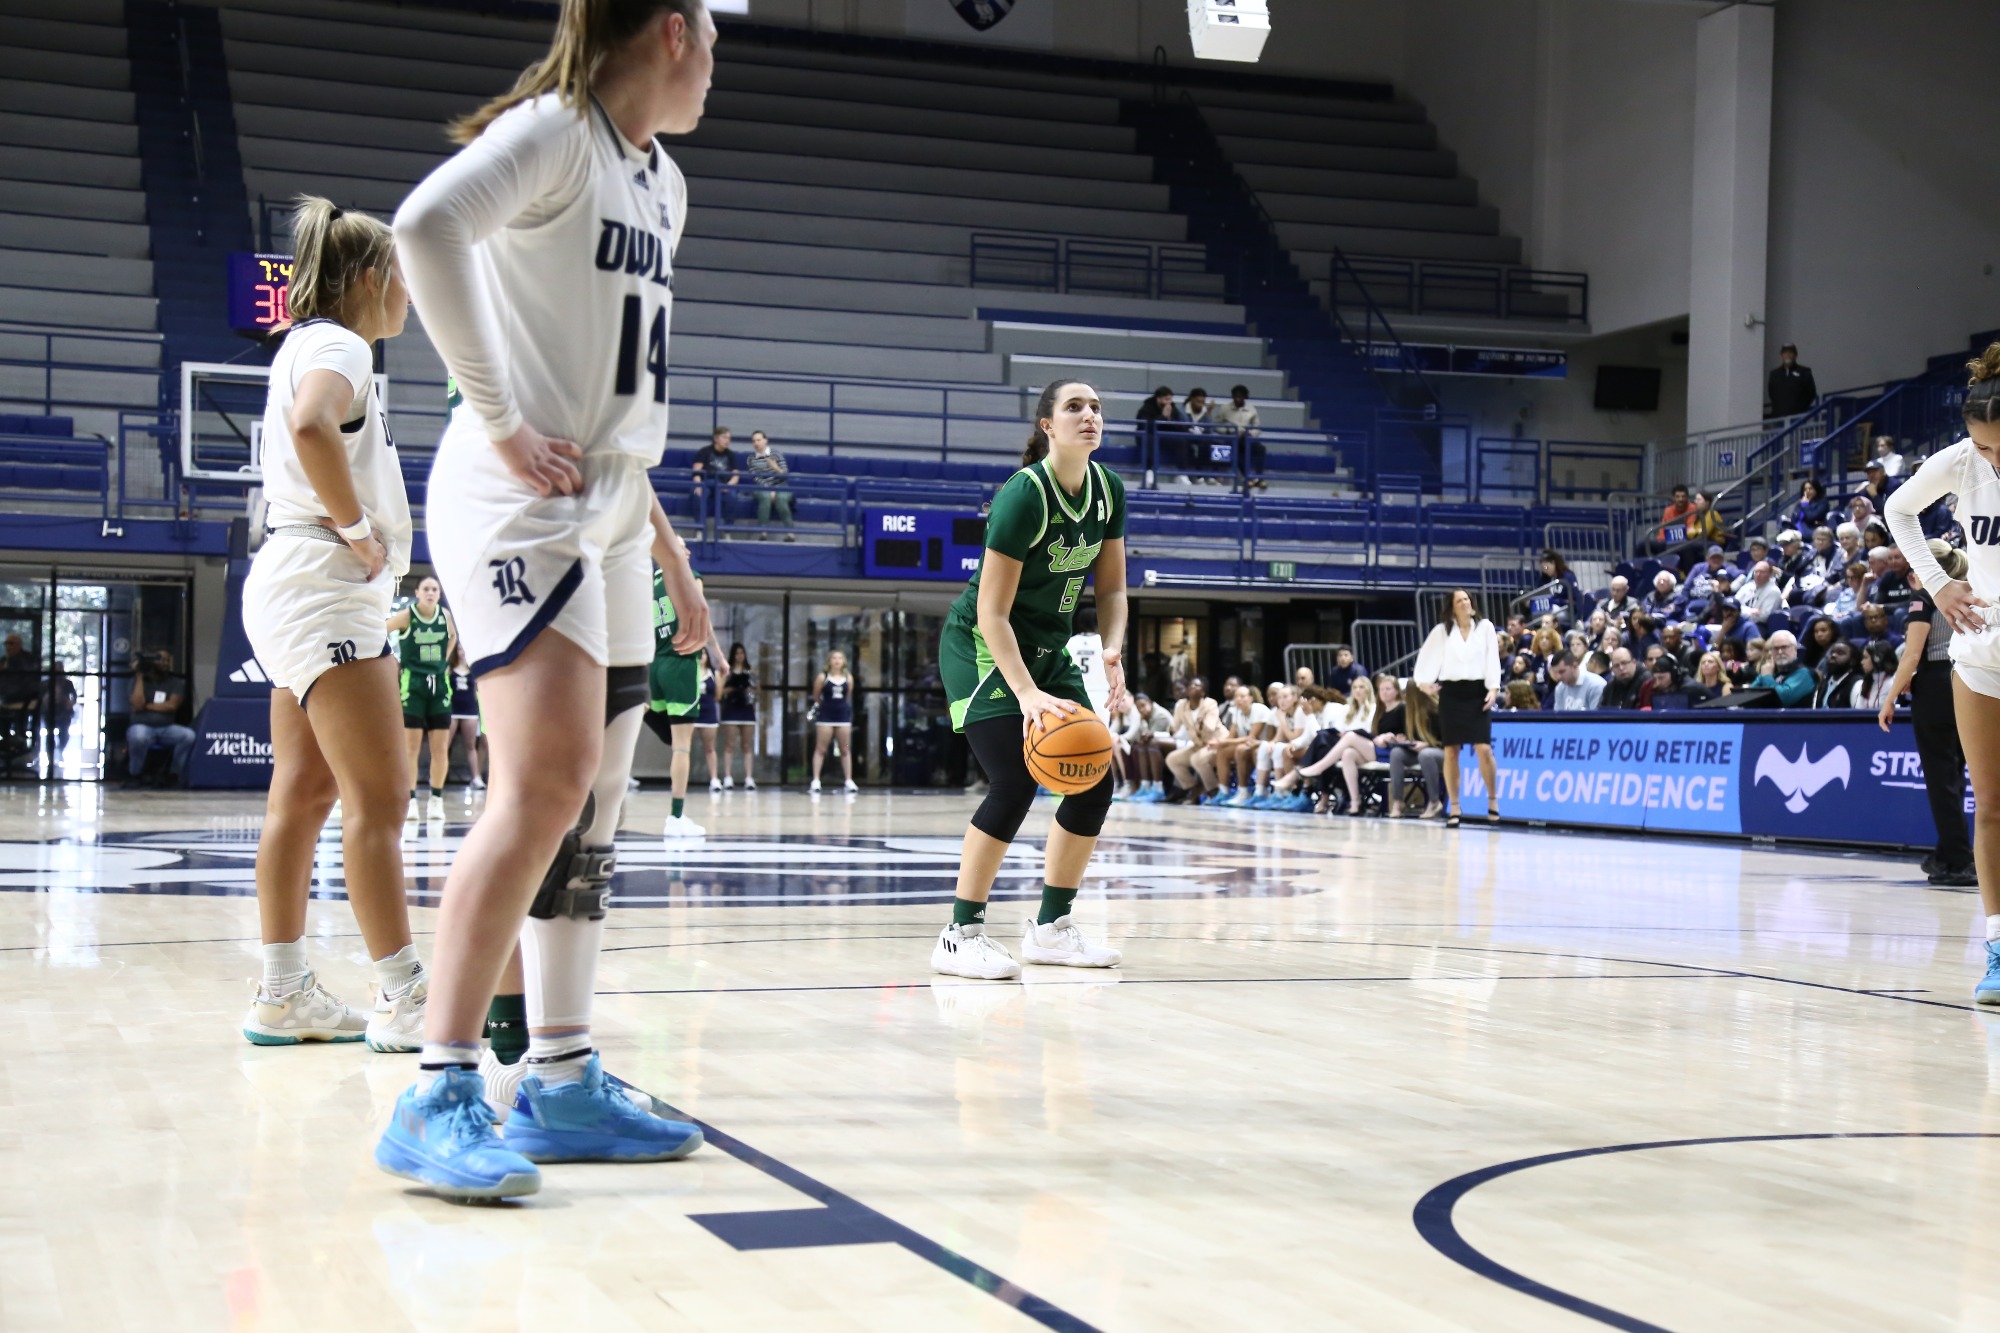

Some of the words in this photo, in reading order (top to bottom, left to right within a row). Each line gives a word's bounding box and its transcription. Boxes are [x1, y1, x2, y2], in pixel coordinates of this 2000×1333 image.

[595, 218, 673, 290] OWL
[615, 294, 667, 404] 14
[882, 515, 916, 533] RICE
[1669, 528, 1684, 541] 110
[1080, 657, 1090, 674] 5
[205, 732, 247, 740] HOUSTON
[205, 735, 274, 756] Metho
[1502, 737, 1545, 759] WILL
[1550, 738, 1600, 762] HELP
[1606, 740, 1649, 763] YOU
[1654, 740, 1733, 765] RETIRE
[1463, 767, 1529, 800] WTH
[1535, 769, 1727, 812] CONFIDENCE
